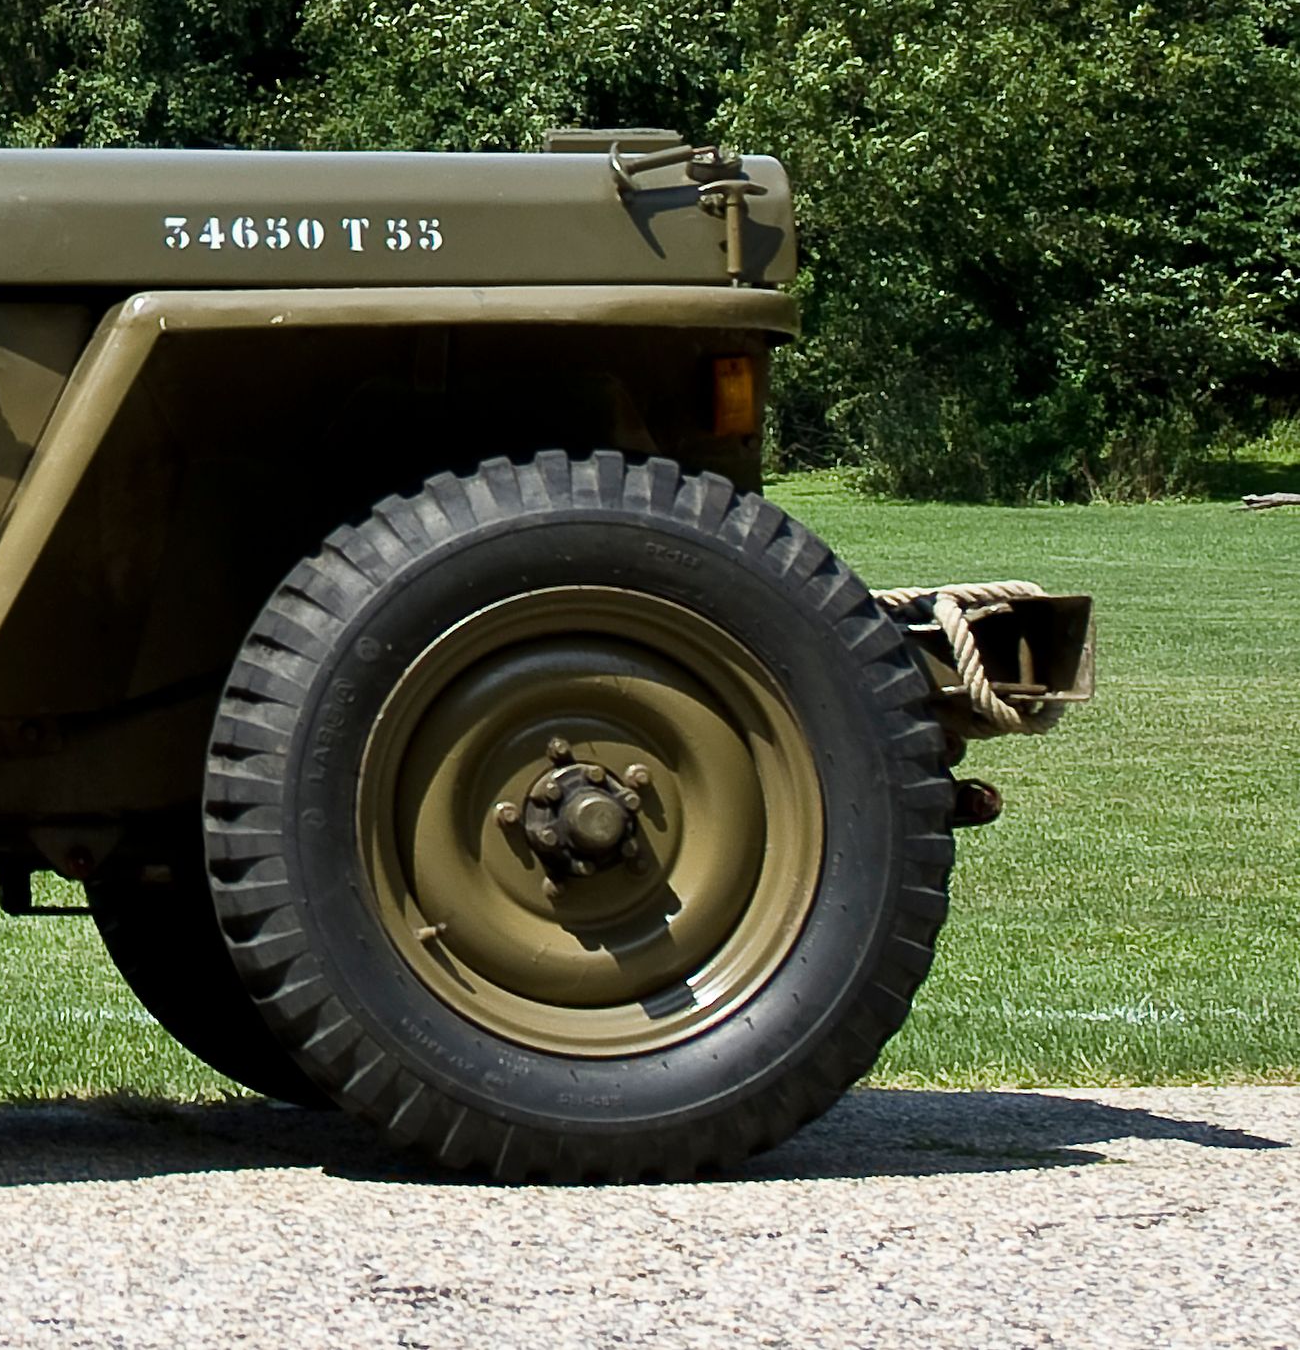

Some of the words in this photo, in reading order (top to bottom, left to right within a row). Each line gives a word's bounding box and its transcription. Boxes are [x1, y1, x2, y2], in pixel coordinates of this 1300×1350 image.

[164, 216, 326, 250] 34650
[341, 217, 370, 252] T
[386, 218, 444, 251] 55
